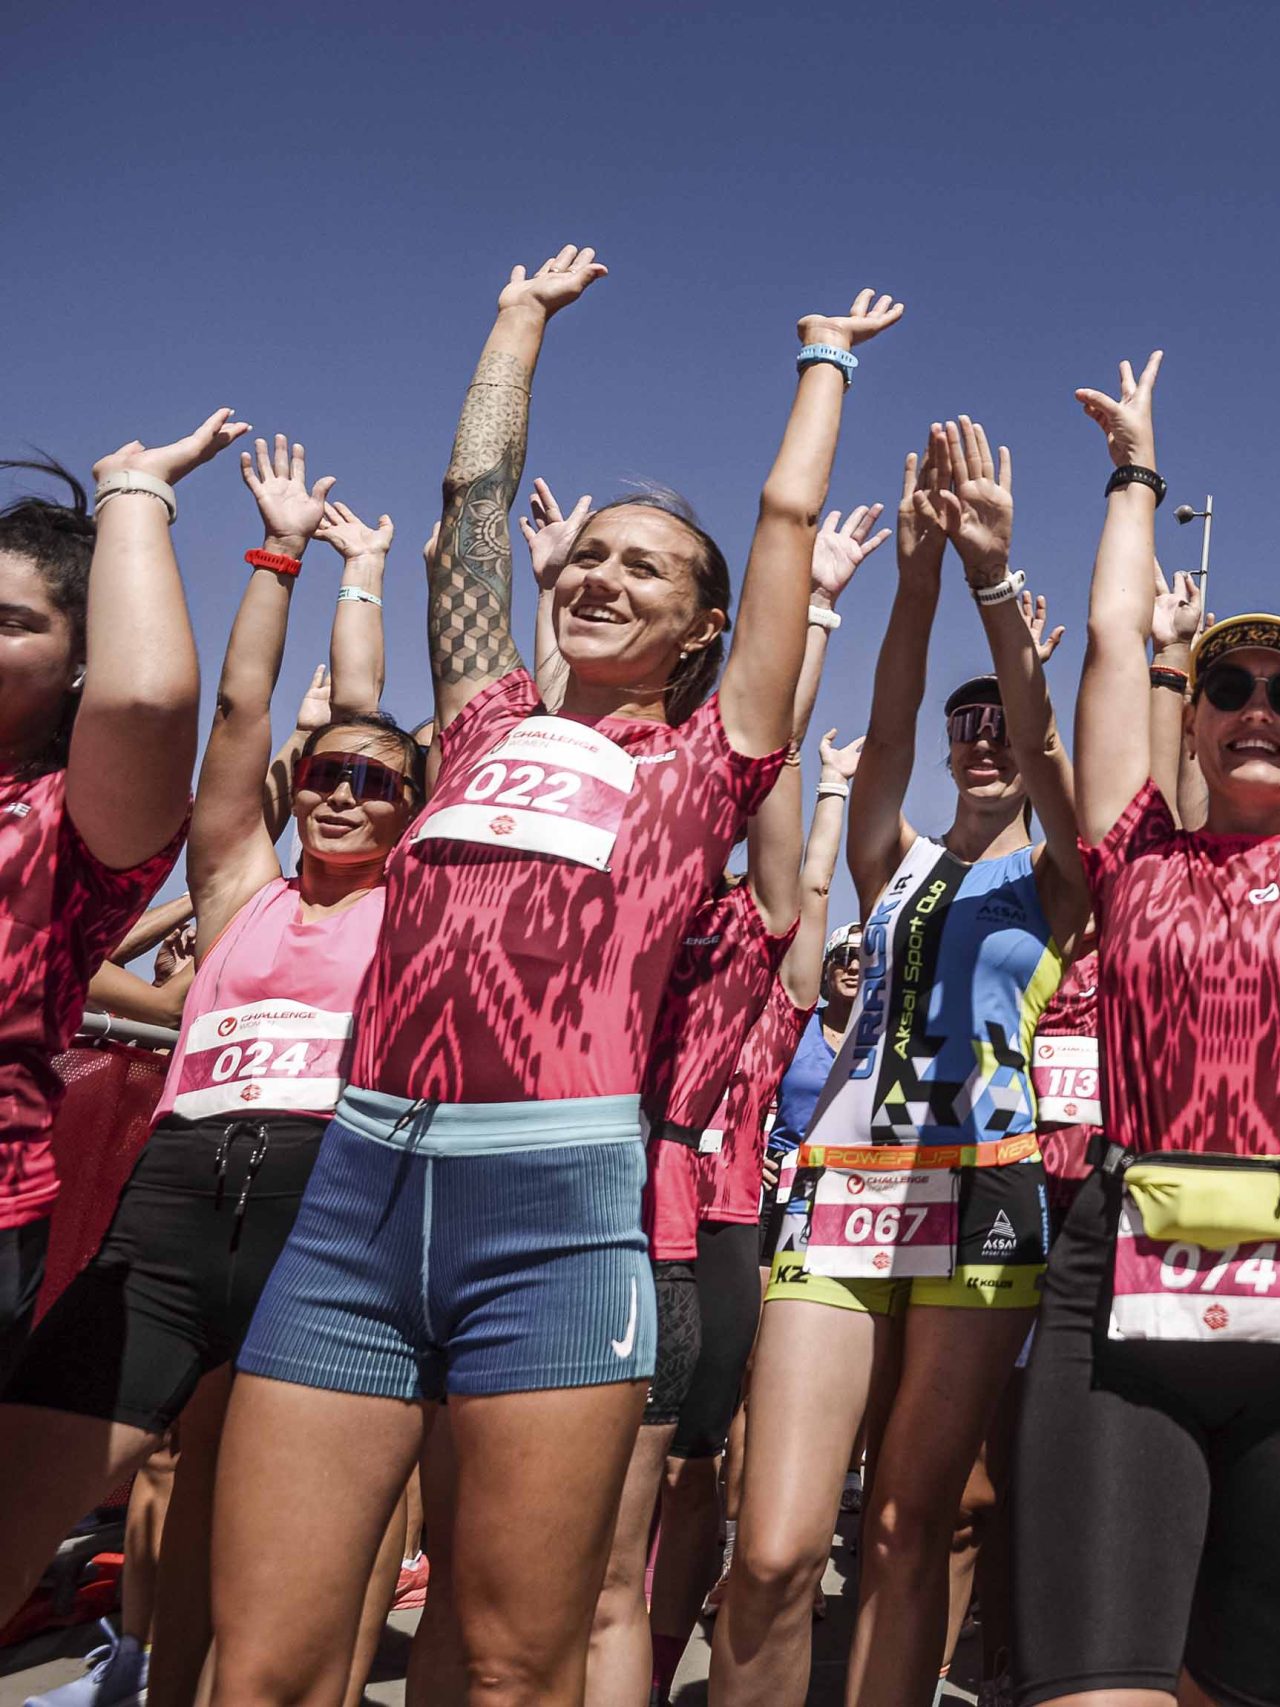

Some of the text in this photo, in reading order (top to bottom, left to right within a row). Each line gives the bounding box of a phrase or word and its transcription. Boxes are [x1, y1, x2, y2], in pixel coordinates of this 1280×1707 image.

[513, 731, 600, 753] CHALLENGE
[464, 762, 582, 812] 022
[904, 916, 926, 983] Sport
[849, 899, 902, 1080] URALSK
[240, 1011, 317, 1022] CHALLENGE
[894, 989, 916, 1060] Aksai
[211, 1041, 310, 1082] 024
[1047, 1068, 1098, 1098] 113
[866, 1175, 930, 1185] CHALLENGE
[844, 1207, 929, 1243] 067
[983, 1239, 1017, 1249] AKSAI
[774, 1264, 809, 1285] KZ
